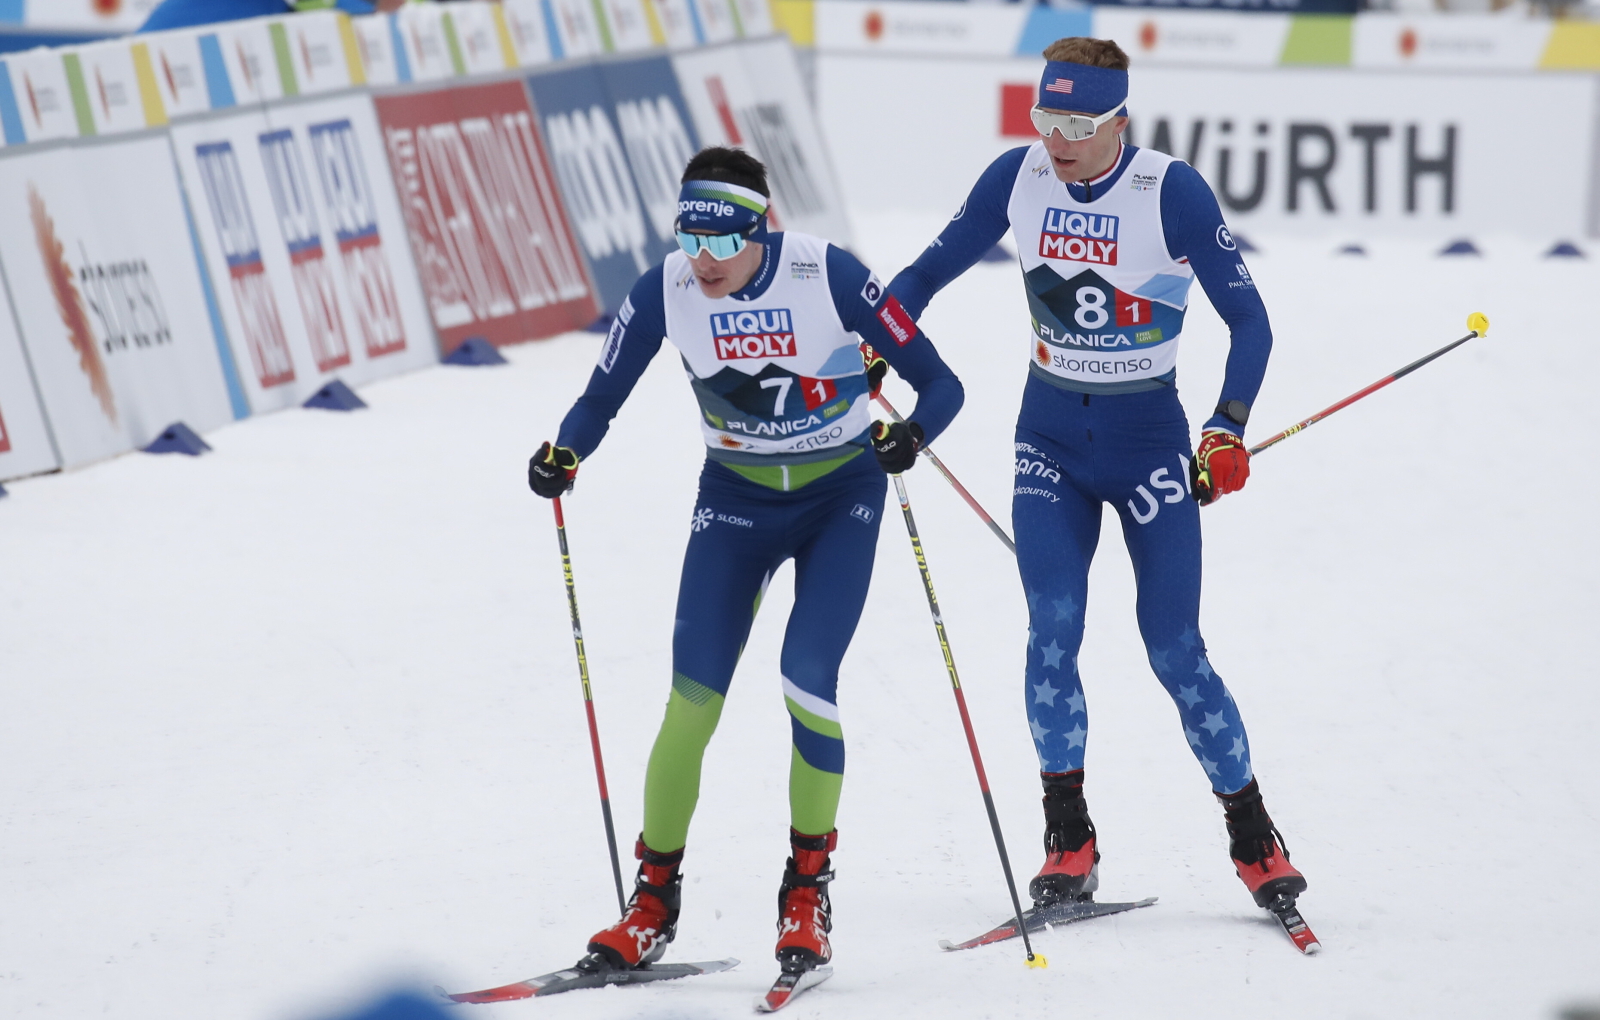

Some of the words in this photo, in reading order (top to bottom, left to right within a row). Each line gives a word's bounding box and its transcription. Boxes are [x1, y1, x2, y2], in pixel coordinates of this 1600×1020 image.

[678, 200, 735, 217] gorenje
[1045, 209, 1116, 240] LIQUI
[1042, 234, 1117, 263] MOLY
[1074, 286, 1109, 329] 8
[1125, 301, 1139, 323] 1
[713, 310, 790, 335] LIQUI
[880, 307, 910, 343] barcaffé
[717, 334, 793, 359] MOLY
[1040, 324, 1132, 347] PLANICA
[760, 377, 793, 417] 7
[811, 381, 827, 402] 1
[726, 415, 822, 435] PLANICA
[716, 513, 754, 528] SLOSKI
